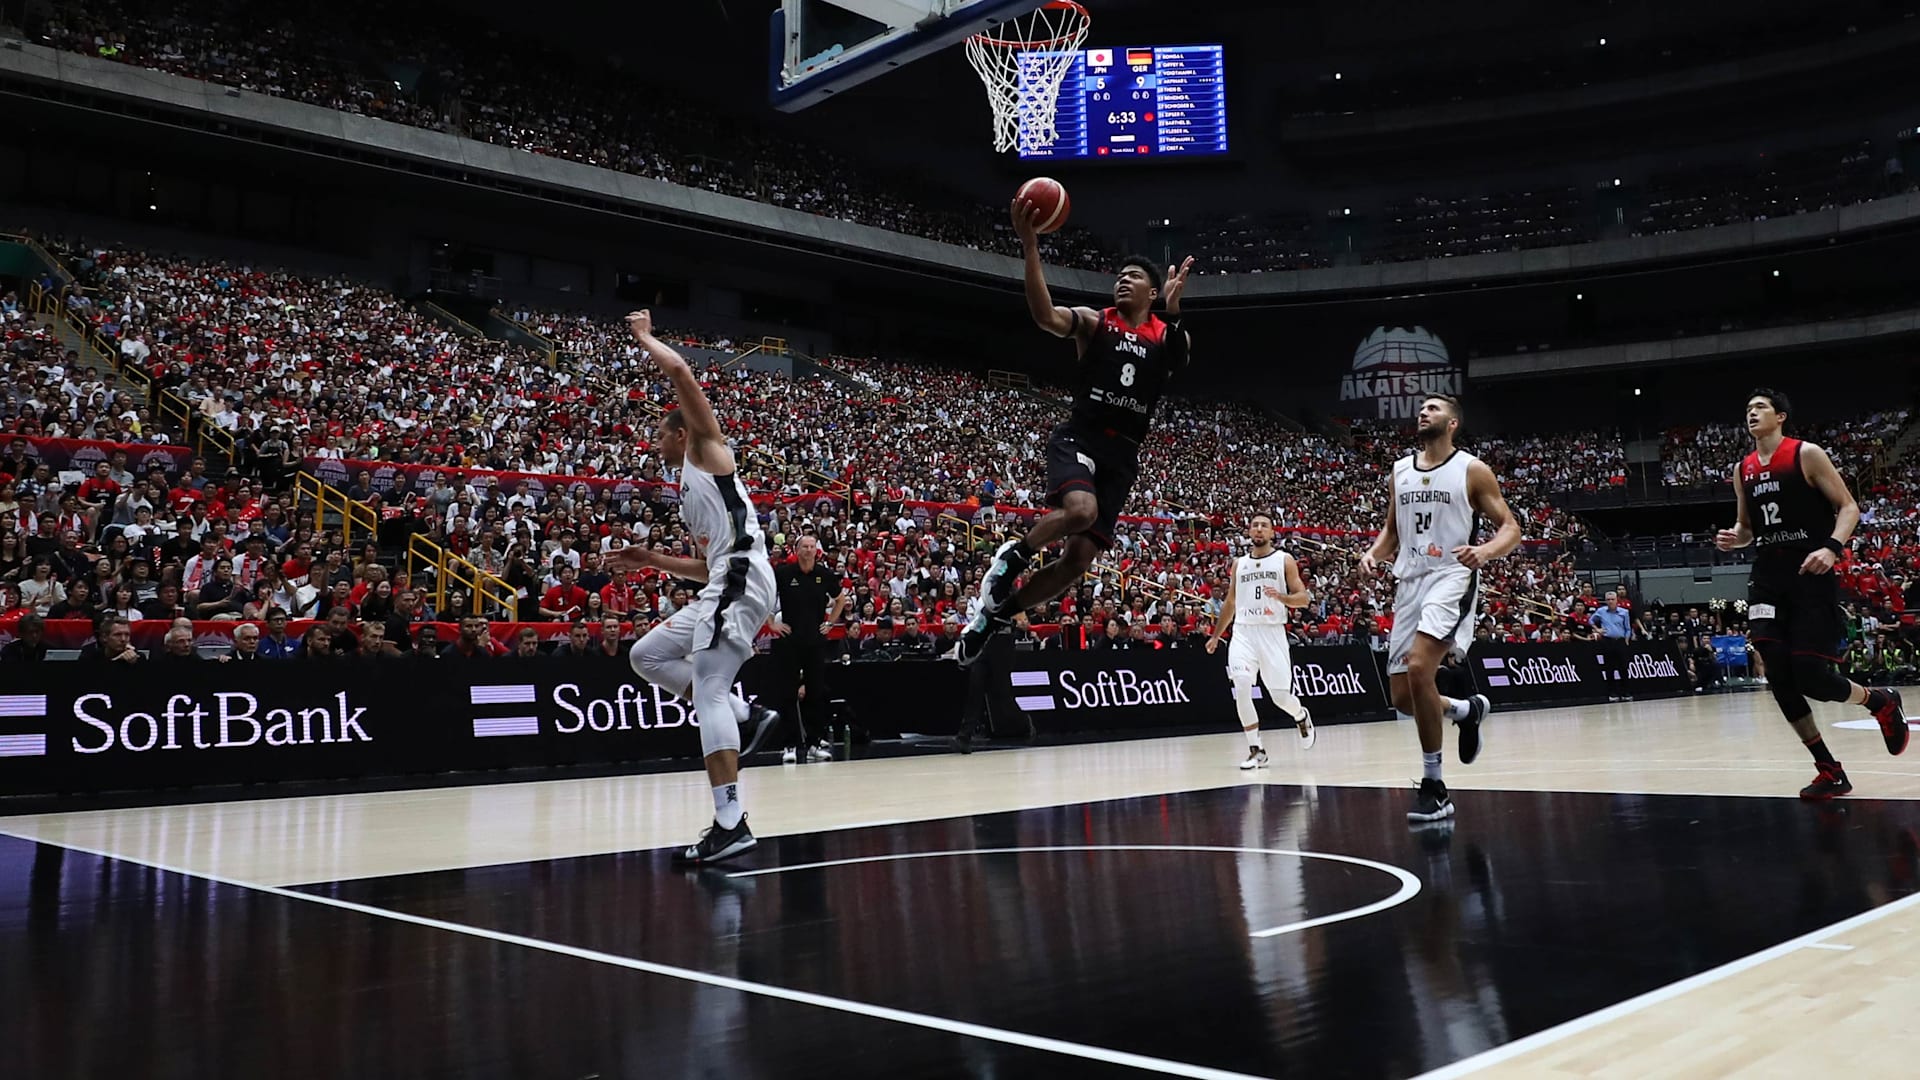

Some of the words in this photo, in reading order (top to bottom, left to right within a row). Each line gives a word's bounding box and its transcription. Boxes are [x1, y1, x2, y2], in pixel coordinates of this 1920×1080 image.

[1096, 77, 1106, 90] 5
[1136, 76, 1145, 88] 9
[1108, 112, 1136, 124] 6:33
[1115, 340, 1147, 359] JAPAN
[1120, 363, 1136, 387] 8
[1340, 366, 1462, 400] AKATSUKI
[1752, 480, 1780, 497] JAPAN
[1760, 502, 1782, 526] 12
[1255, 586, 1261, 600] 8
[1508, 656, 1582, 686] SoftBank
[1627, 653, 1679, 679] oftBank
[1059, 669, 1190, 709] SoftBank
[1291, 663, 1367, 697] ftBank
[72, 691, 373, 754] SoftBank
